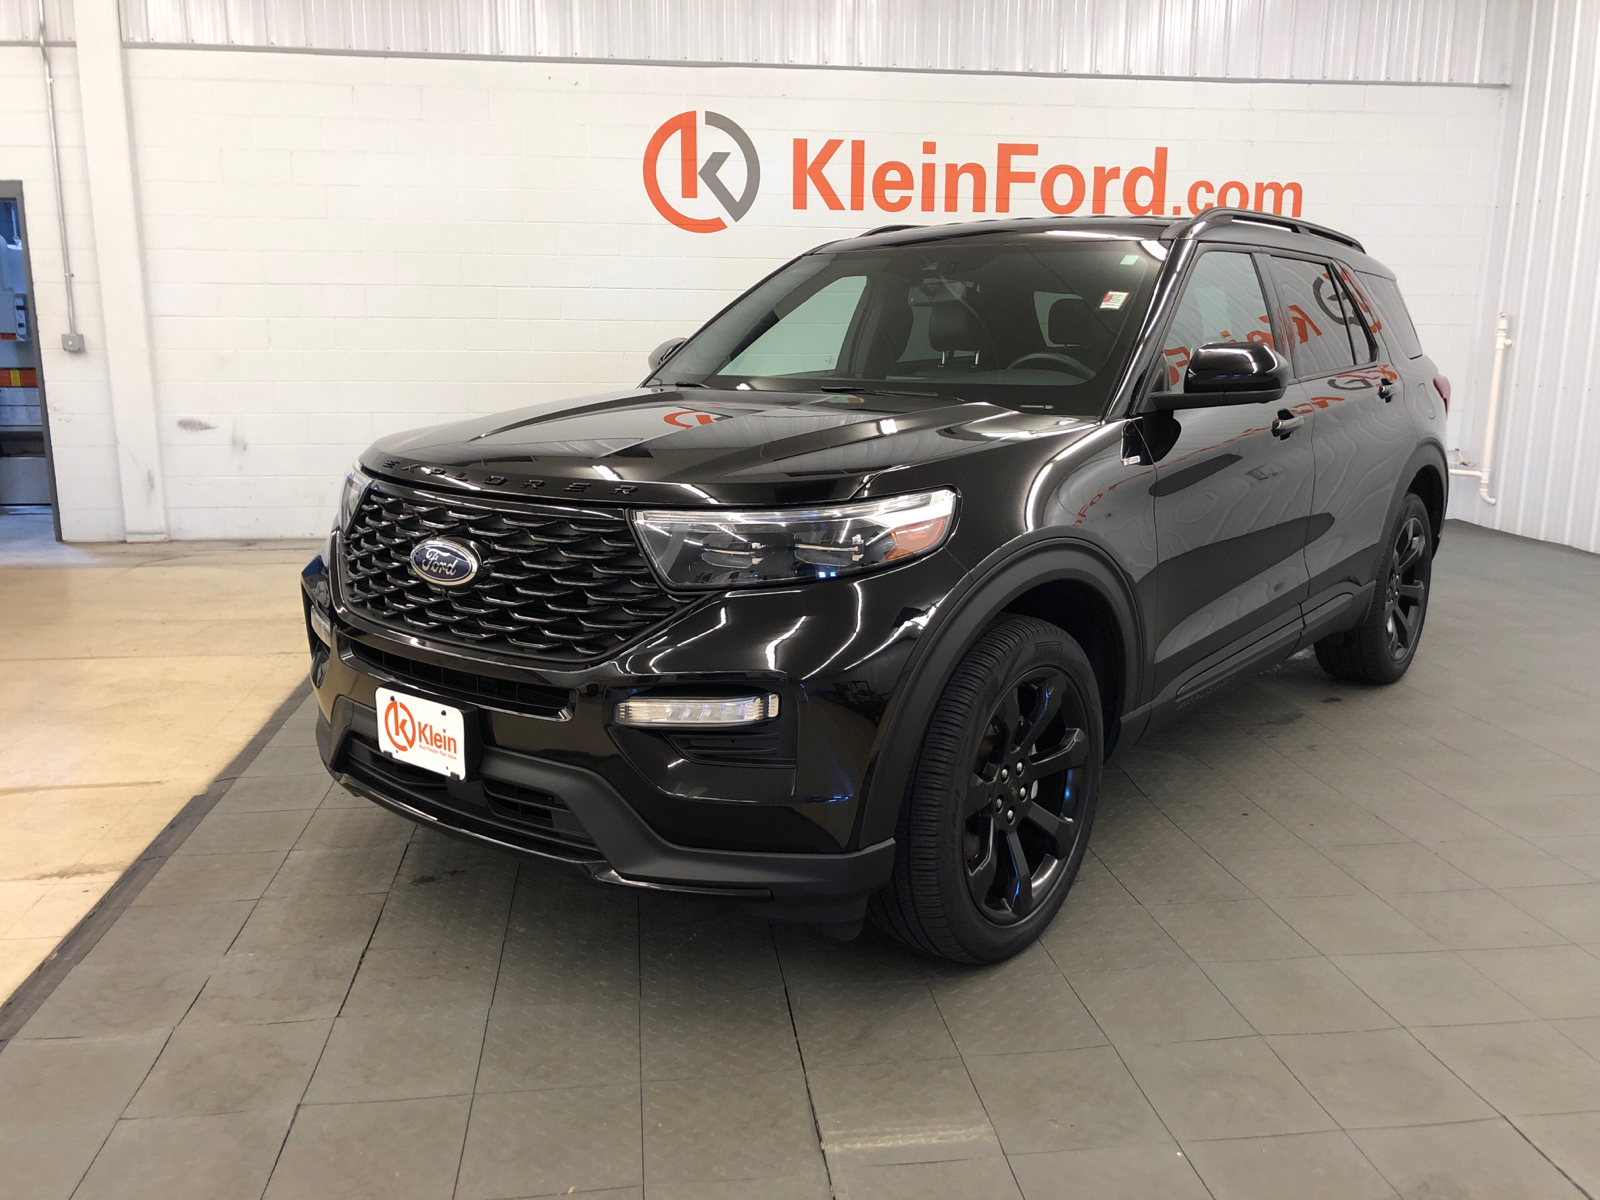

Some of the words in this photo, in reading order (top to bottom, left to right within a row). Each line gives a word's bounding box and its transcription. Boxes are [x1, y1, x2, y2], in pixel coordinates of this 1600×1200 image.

[792, 138, 1303, 218] KleinFord.com
[382, 460, 639, 496] EXPLORER
[422, 547, 459, 576] Ford
[418, 721, 457, 754] Klein
